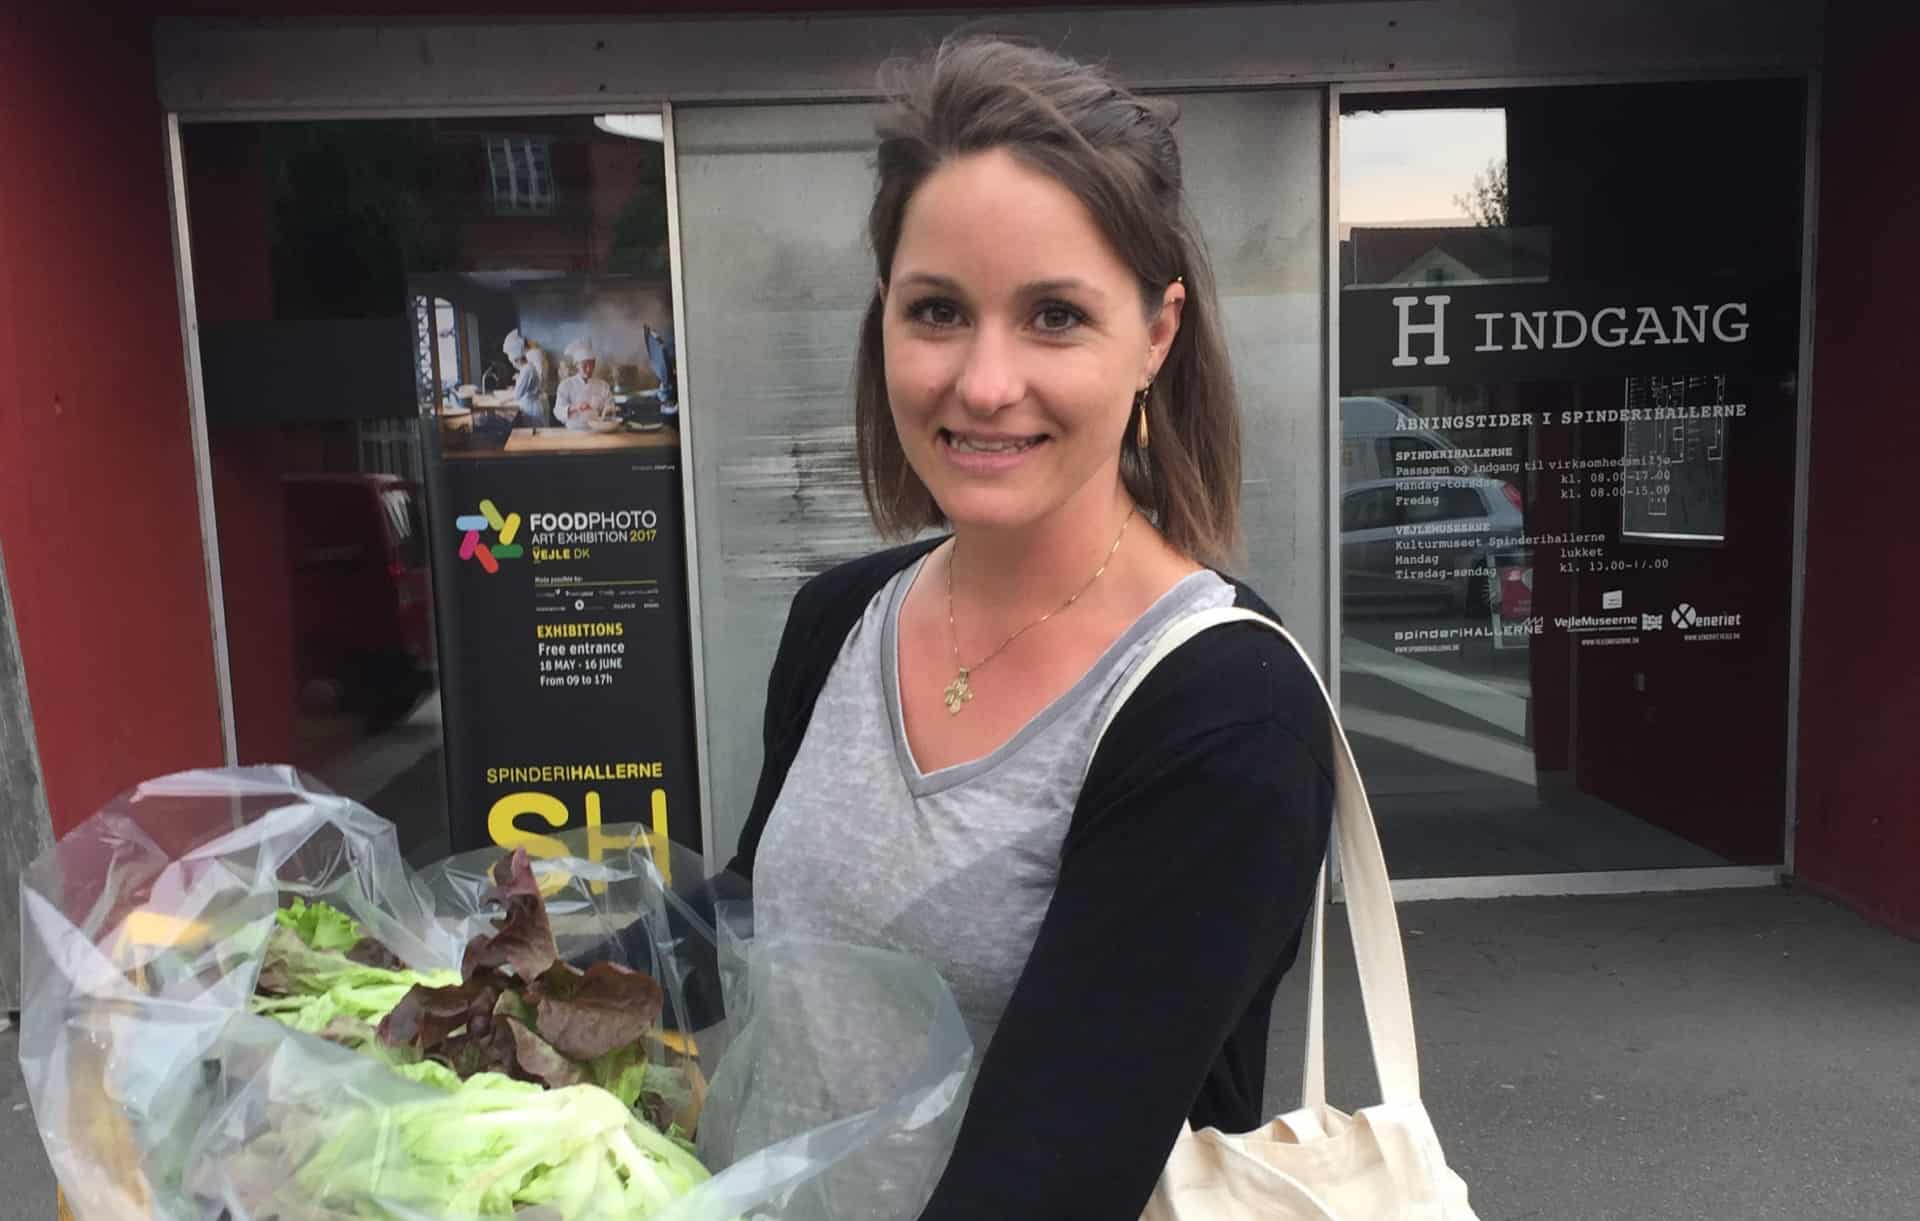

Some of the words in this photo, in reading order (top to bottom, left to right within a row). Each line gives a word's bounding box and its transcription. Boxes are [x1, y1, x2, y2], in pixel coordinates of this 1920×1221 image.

[1392, 295, 1451, 367] H
[1474, 302, 1750, 352] INDGANG
[1542, 412, 1552, 425] I
[1561, 404, 1747, 424] SPINDERIHALLERNE
[1395, 447, 1513, 461] SPINDERIHALLERNE
[1396, 464, 1450, 476] Passagen
[1454, 464, 1468, 474] og
[1474, 460, 1520, 473] indgang
[1524, 459, 1544, 471] til
[1590, 470, 1671, 483] 08.00-17.00
[1395, 494, 1440, 507] Fredag
[1590, 485, 1671, 498] 08.00-15.00
[530, 510, 658, 532] FOODPHOTO
[1395, 523, 1491, 535] VEJLEMUSEERNE
[532, 532, 555, 545] ART
[557, 530, 628, 544] EXHIBITION
[629, 529, 657, 543] 2017
[1489, 532, 1606, 547] Spinderihallerne
[532, 547, 571, 561] VEJLE
[574, 547, 591, 560] DK
[1395, 554, 1440, 566] Mandag
[1560, 548, 1604, 558] lukket
[1395, 567, 1497, 579] Tirsdag-søndag
[1554, 614, 1638, 629] VejleMuseerne
[536, 622, 624, 639] EXHIBITIONS
[1394, 623, 1544, 641] spinderiHALLERNE
[538, 643, 566, 657] Free
[569, 640, 625, 655] entrance
[540, 660, 552, 671] 18
[554, 658, 576, 671] MAY
[585, 658, 597, 670] 16
[599, 657, 623, 671] JUNE
[540, 675, 565, 687] From
[566, 675, 580, 686] 09
[582, 674, 592, 685] to
[594, 673, 613, 686] 17h
[487, 762, 663, 784] SPINDERIHALLERNE
[487, 788, 672, 897] SH
